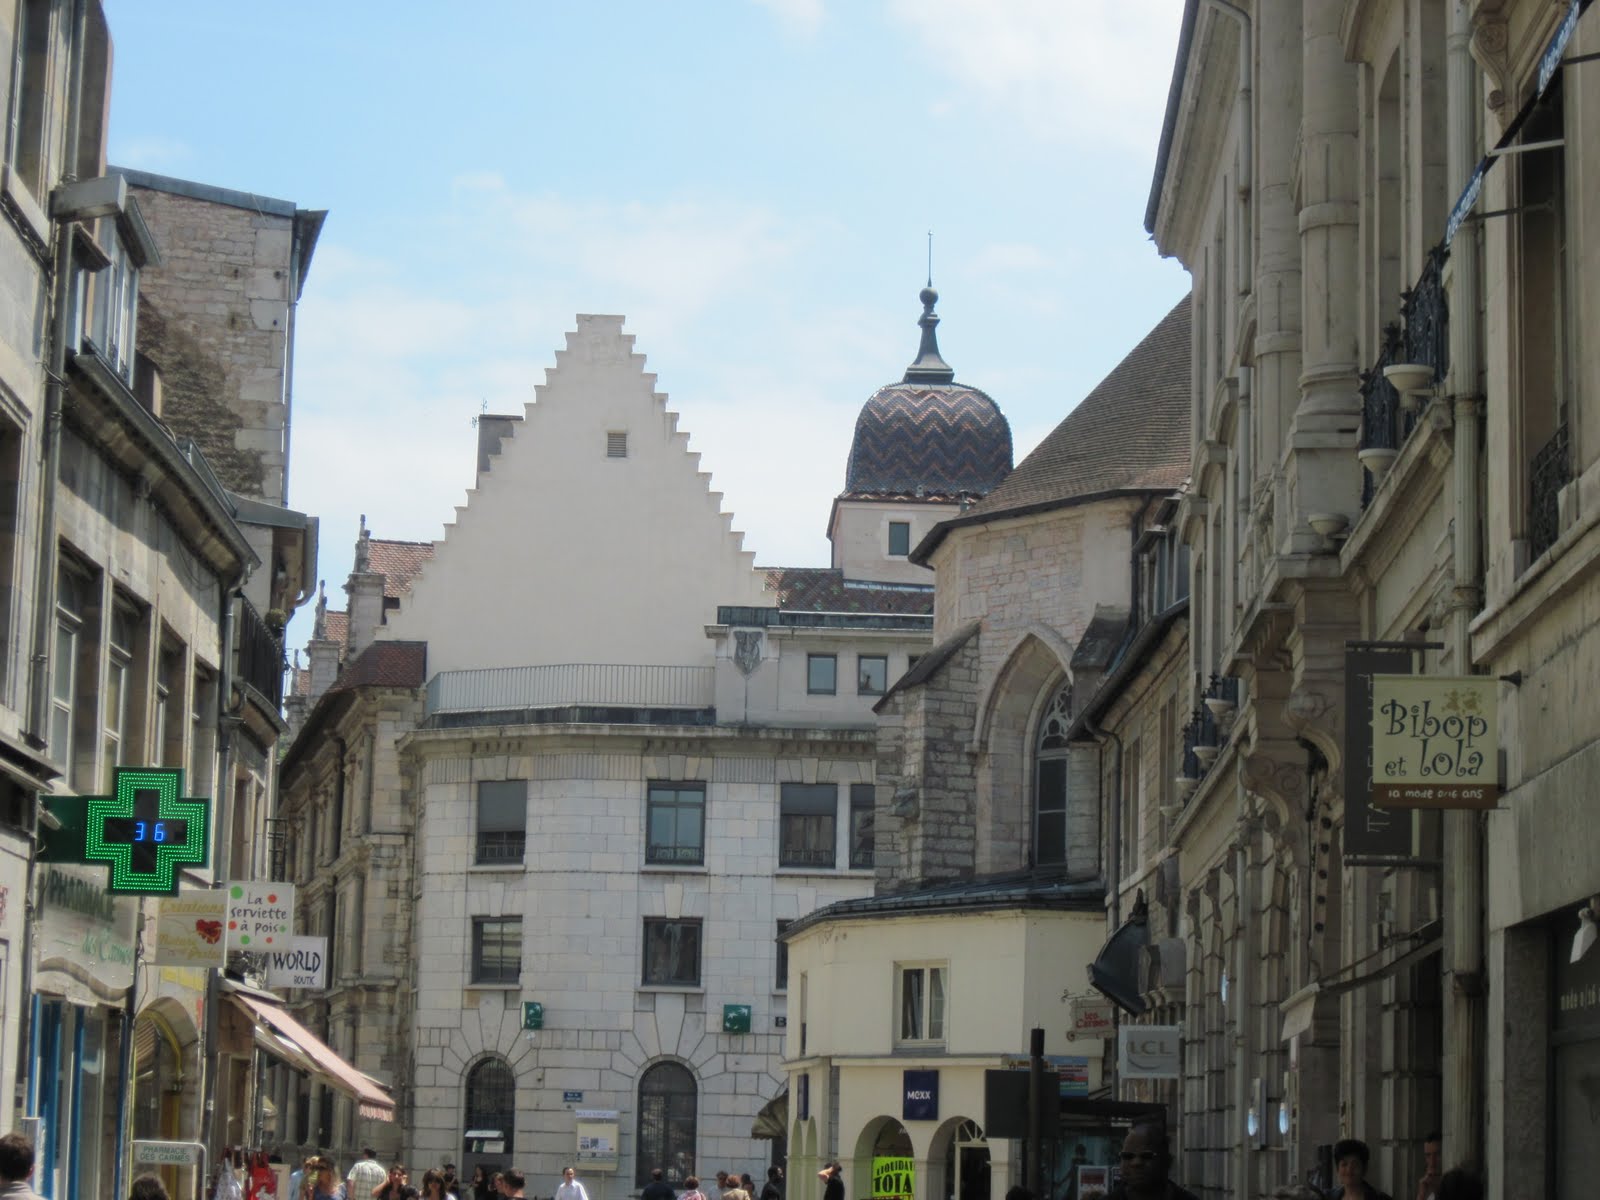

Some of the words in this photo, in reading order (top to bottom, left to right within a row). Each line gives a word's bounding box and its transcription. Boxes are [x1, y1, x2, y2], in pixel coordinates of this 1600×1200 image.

[1380, 699, 1488, 748] Bibop
[1385, 756, 1407, 776] et
[1405, 789, 1434, 799] mode
[1462, 789, 1484, 799] ans
[247, 892, 263, 905] La
[230, 906, 287, 920] serviette
[240, 919, 248, 931] à
[273, 950, 321, 973] WORLD
[1129, 1040, 1175, 1055] LCL
[143, 1146, 187, 1155] PHARMACIE
[158, 1154, 190, 1162] CARMES
